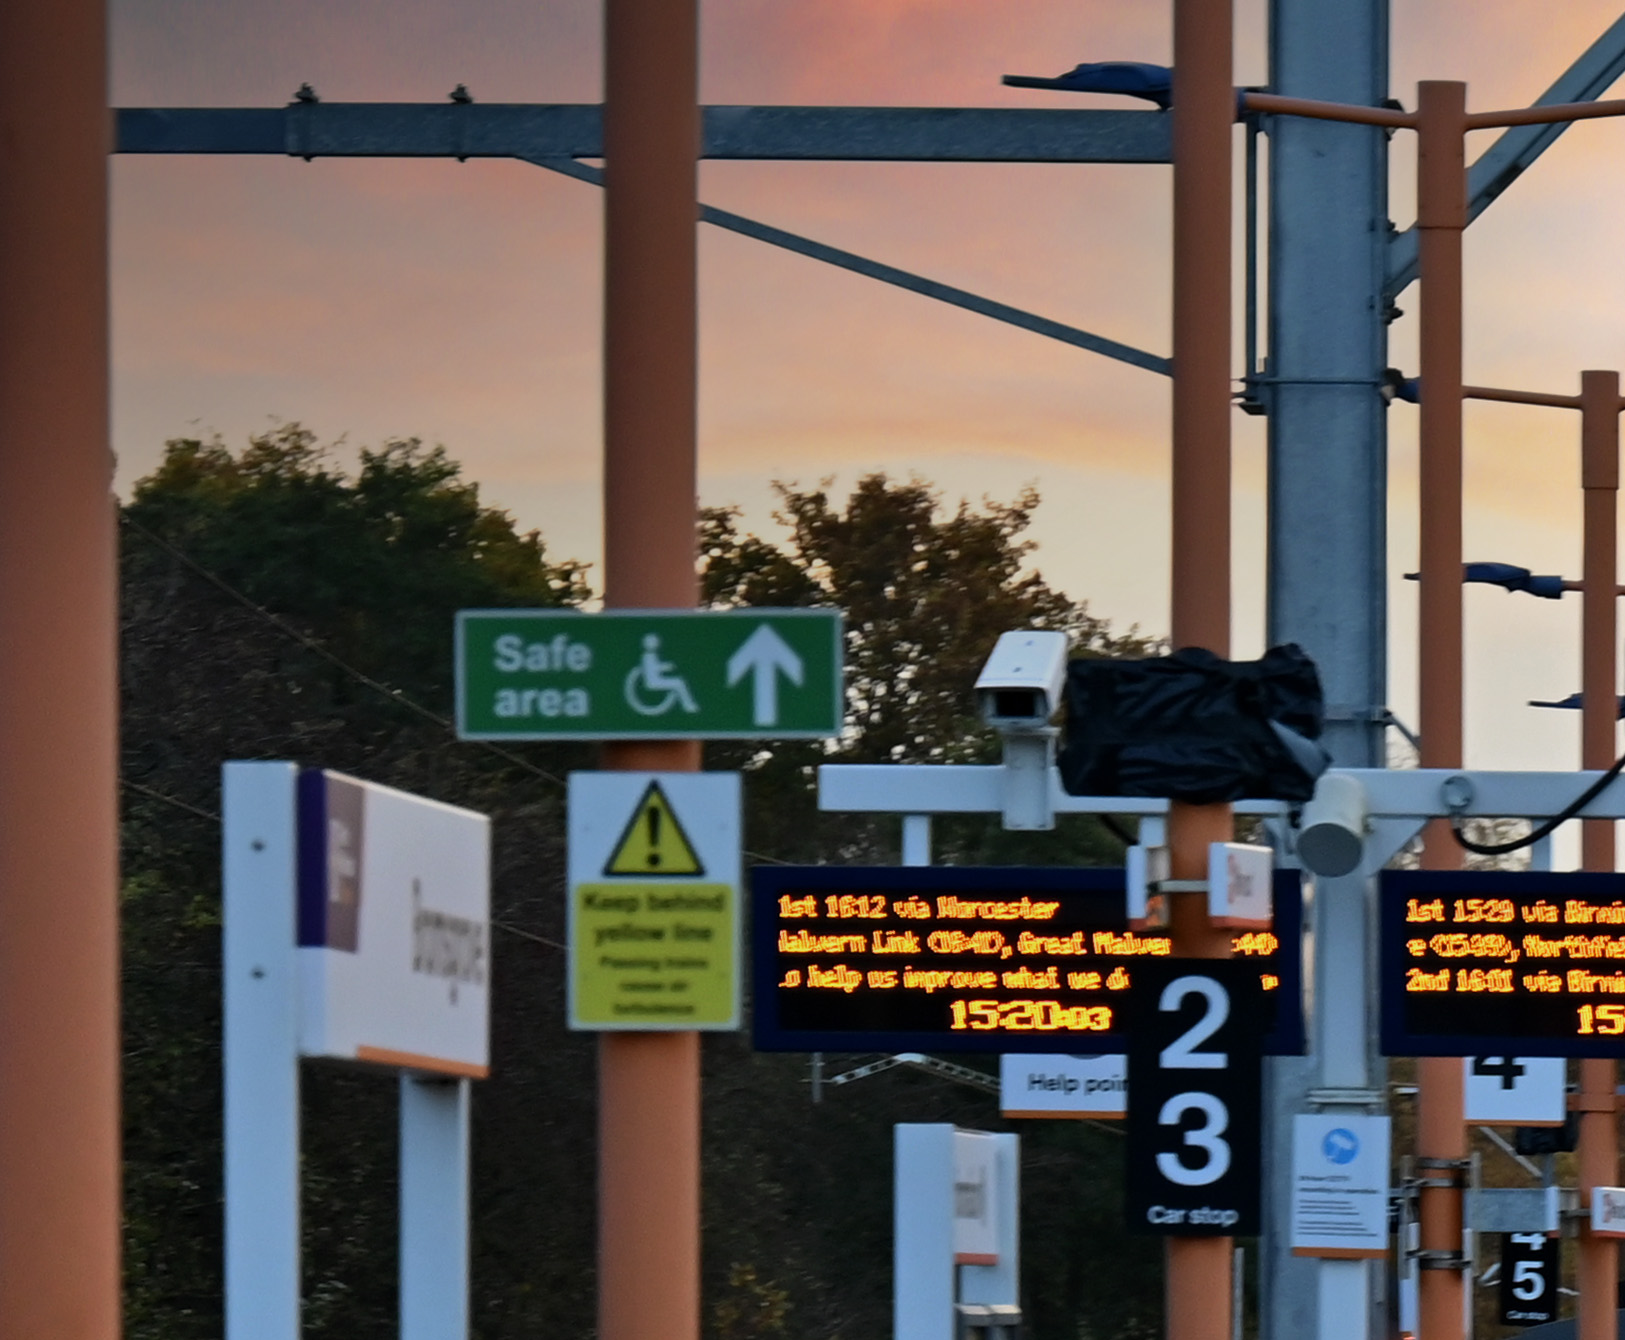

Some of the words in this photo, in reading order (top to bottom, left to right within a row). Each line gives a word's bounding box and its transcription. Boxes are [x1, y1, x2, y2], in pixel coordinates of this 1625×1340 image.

[493, 634, 593, 672] Safe
[493, 688, 590, 718] area
[582, 893, 640, 916] Keep
[647, 893, 725, 912] behind
[778, 895, 818, 918] 1st
[893, 896, 931, 919] via
[1406, 899, 1445, 922] 1st
[1522, 900, 1559, 923] via
[594, 923, 663, 946] yellow
[673, 923, 713, 941] line
[872, 930, 921, 954] Link
[1017, 931, 1087, 955] Great
[807, 964, 863, 993] help
[867, 971, 899, 988] us
[903, 966, 998, 993] improve
[1002, 966, 1060, 989] what
[1067, 972, 1102, 990] we
[1406, 968, 1450, 991] 2nd
[1523, 970, 1563, 992] via
[1158, 975, 1230, 1069] 2
[1027, 1073, 1077, 1093] Help
[1155, 1091, 1231, 1186] 3
[1146, 1205, 1187, 1224] Car
[1187, 1206, 1240, 1227] stop
[1512, 1260, 1545, 1301] 5
